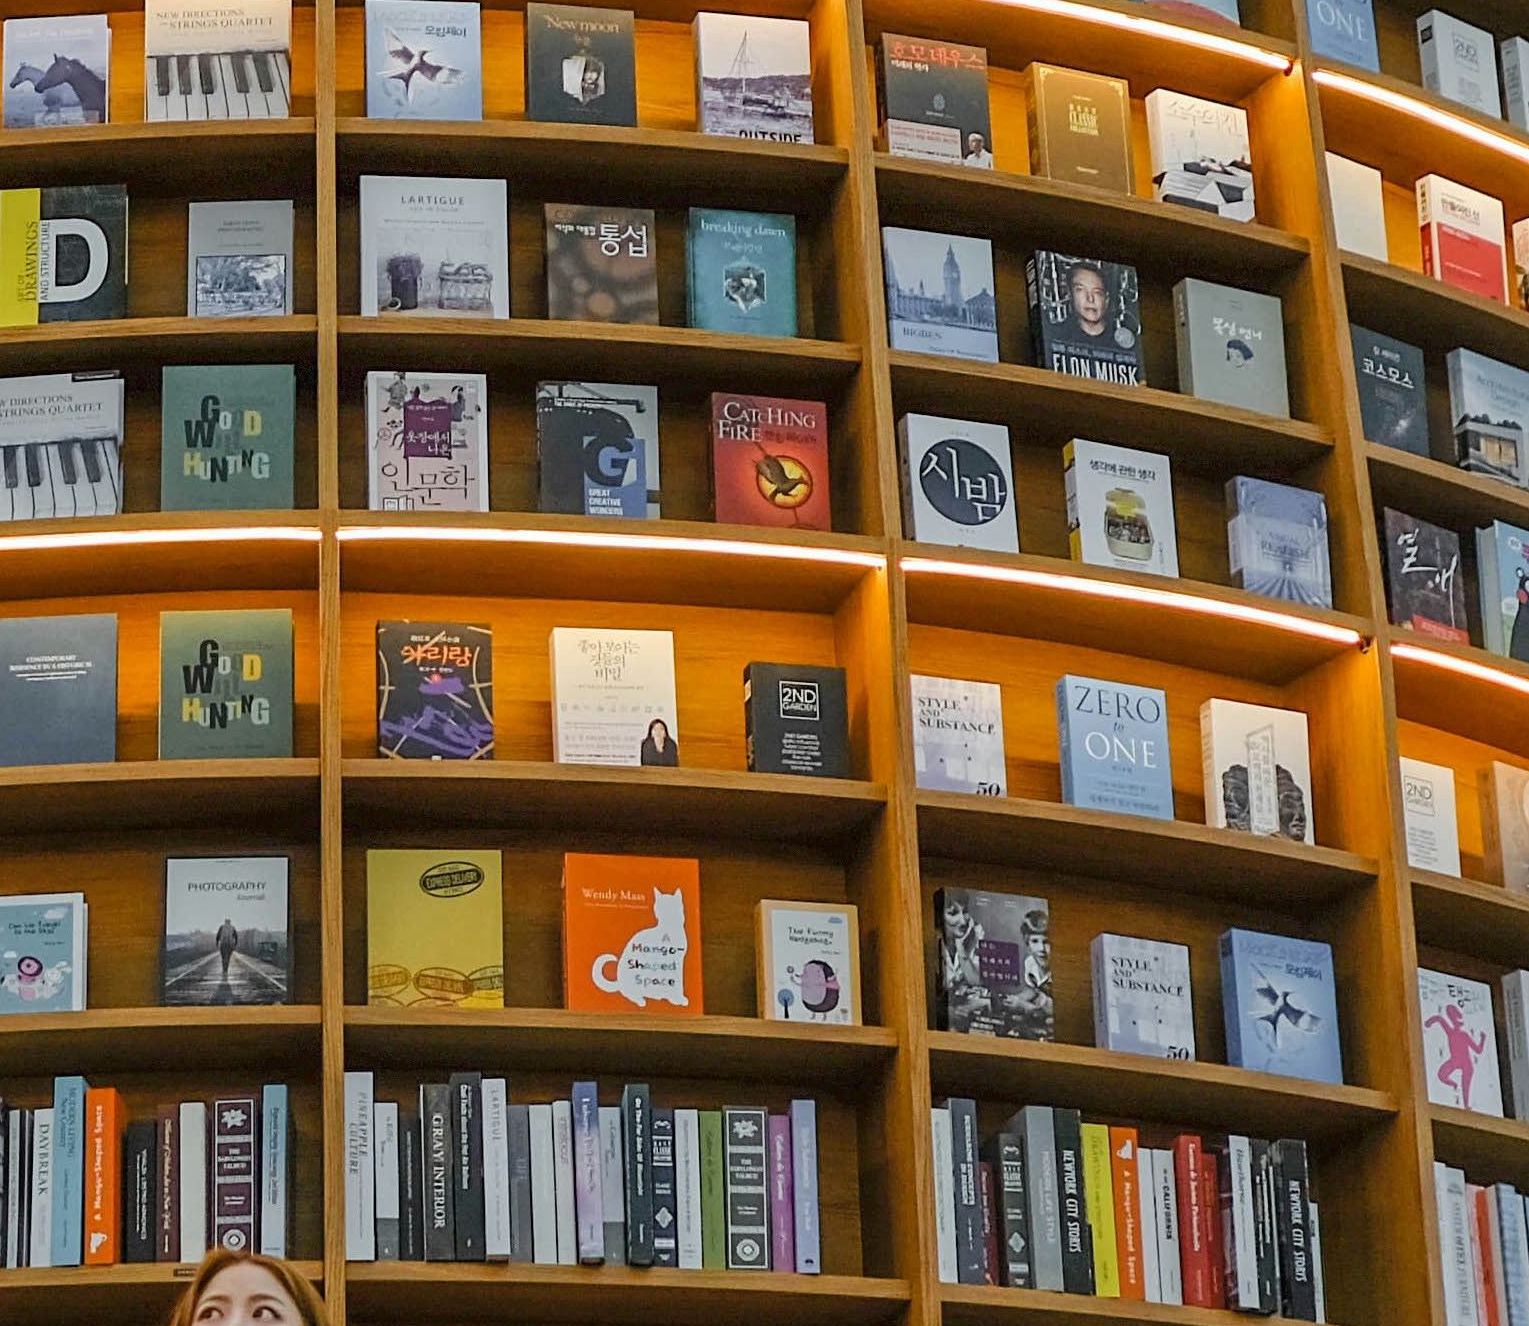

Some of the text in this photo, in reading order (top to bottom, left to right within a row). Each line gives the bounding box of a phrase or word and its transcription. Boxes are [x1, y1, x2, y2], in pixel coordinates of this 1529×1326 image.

[156, 9, 246, 21] NEW DIRECTIONS
[169, 16, 275, 30] STRINGS QUARTET
[543, 14, 621, 35] New moon
[1315, 0, 1369, 43] ONE
[401, 194, 465, 206] LARTIGUE
[700, 219, 786, 241] breaking dawn
[598, 223, 649, 260] 통섭
[24, 220, 39, 304] DRAWINGS
[39, 219, 50, 303] AND STRUCTURE
[1051, 351, 1140, 388] ELON MUSK
[1359, 356, 1415, 389] 코스모스
[8, 395, 74, 407] DIRECTIONS
[48, 402, 105, 417] QUARTET
[723, 401, 817, 432] CATCHING
[717, 418, 764, 444] FIRE
[183, 449, 270, 483] HUNTING
[1089, 458, 1157, 481] 생각에 관한 생각
[380, 459, 476, 506] 인문학
[920, 446, 1008, 523] 시밤
[588, 488, 611, 499] GREAT
[588, 497, 623, 509] CREATIVE
[400, 643, 474, 669] 아리랑
[781, 687, 818, 705] 2ND
[917, 696, 961, 712] STYLE
[1074, 683, 1162, 727] ZERO
[182, 693, 270, 729] HUNTING
[781, 702, 818, 714] GARDEN
[919, 708, 946, 720] AND
[918, 716, 996, 736] SUBSTANCE
[1112, 720, 1125, 732] to
[1083, 730, 1158, 771] ONE
[975, 782, 1001, 797] 50
[1406, 781, 1433, 801] 2ND
[187, 880, 267, 894] PHOTOGRAPHY
[582, 887, 647, 904] Wendy Mass
[631, 942, 685, 957] Mango-
[627, 958, 677, 972] Shaped
[1110, 955, 1154, 973] STYLE
[1112, 969, 1138, 980] AND
[634, 974, 676, 988] Space
[1111, 977, 1186, 999] SUBSTANCE
[1166, 1045, 1191, 1061] 50
[38, 1122, 50, 1197] DAYBREAK
[430, 1112, 446, 1230] GRAY INTERIOR
[1062, 1149, 1078, 1195] NEWYORK
[1064, 1197, 1079, 1219] CITY
[1288, 1179, 1303, 1225] NEWYORK
[1291, 1227, 1305, 1248] CITY
